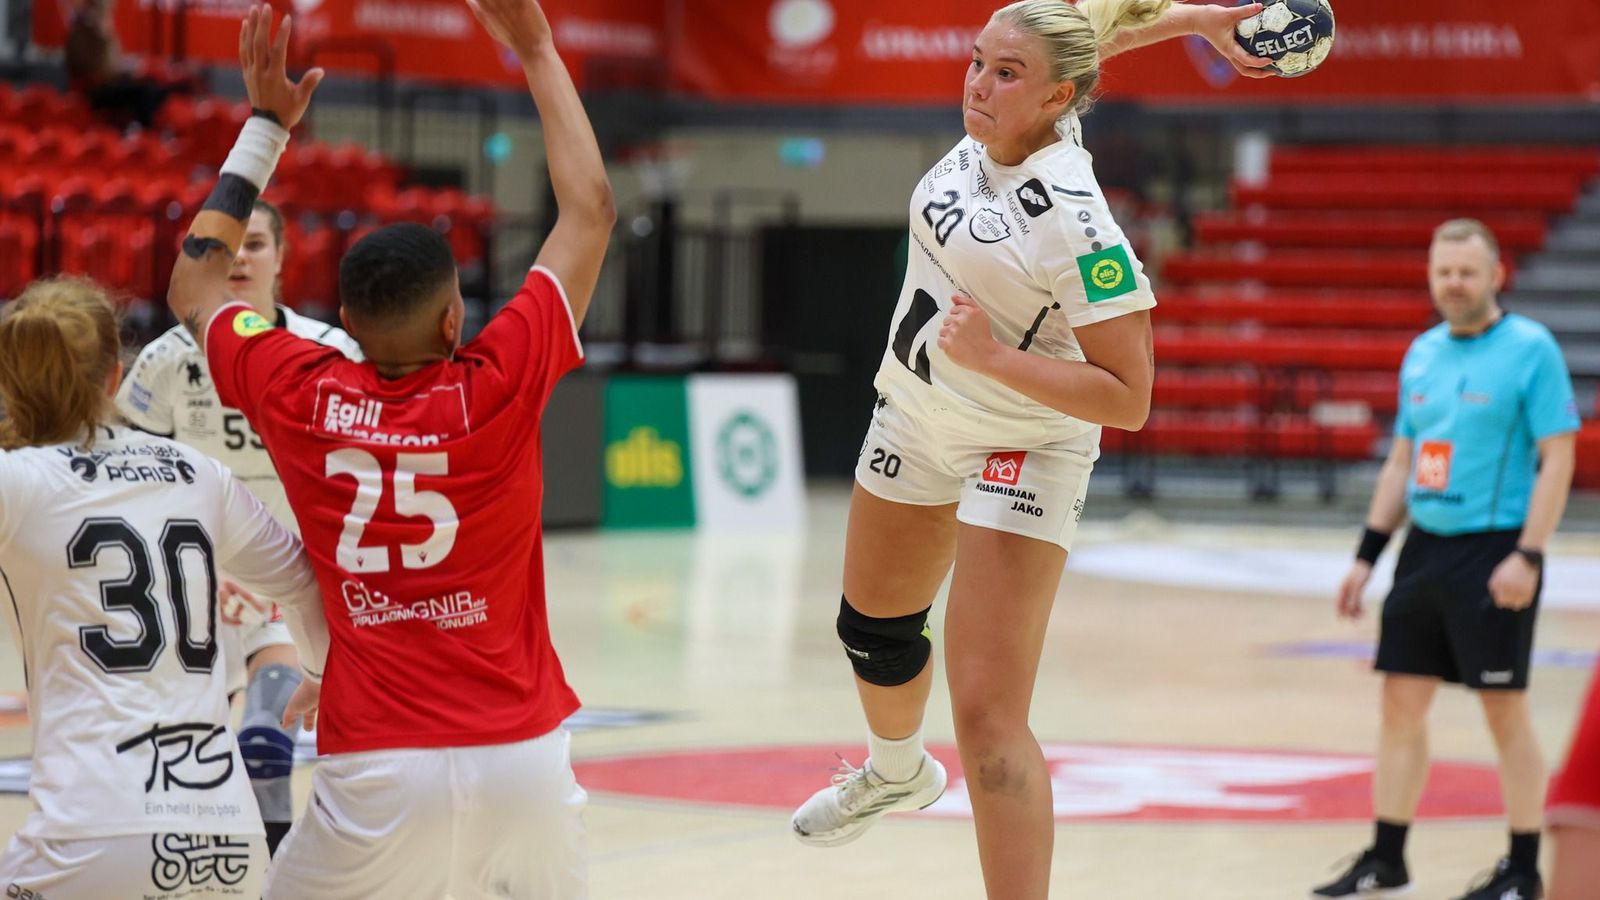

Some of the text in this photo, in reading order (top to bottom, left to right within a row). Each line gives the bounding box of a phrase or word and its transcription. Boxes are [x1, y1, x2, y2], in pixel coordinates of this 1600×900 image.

[1255, 24, 1314, 56] SELECT
[958, 148, 969, 171] JAKO
[922, 189, 966, 248] 20
[326, 394, 383, 429] Egill
[869, 448, 901, 478] 20
[325, 447, 460, 574] 25
[1010, 501, 1044, 517] JAKO
[66, 516, 218, 674] 30
[116, 722, 234, 794] TRS
[145, 802, 163, 815] Ein
